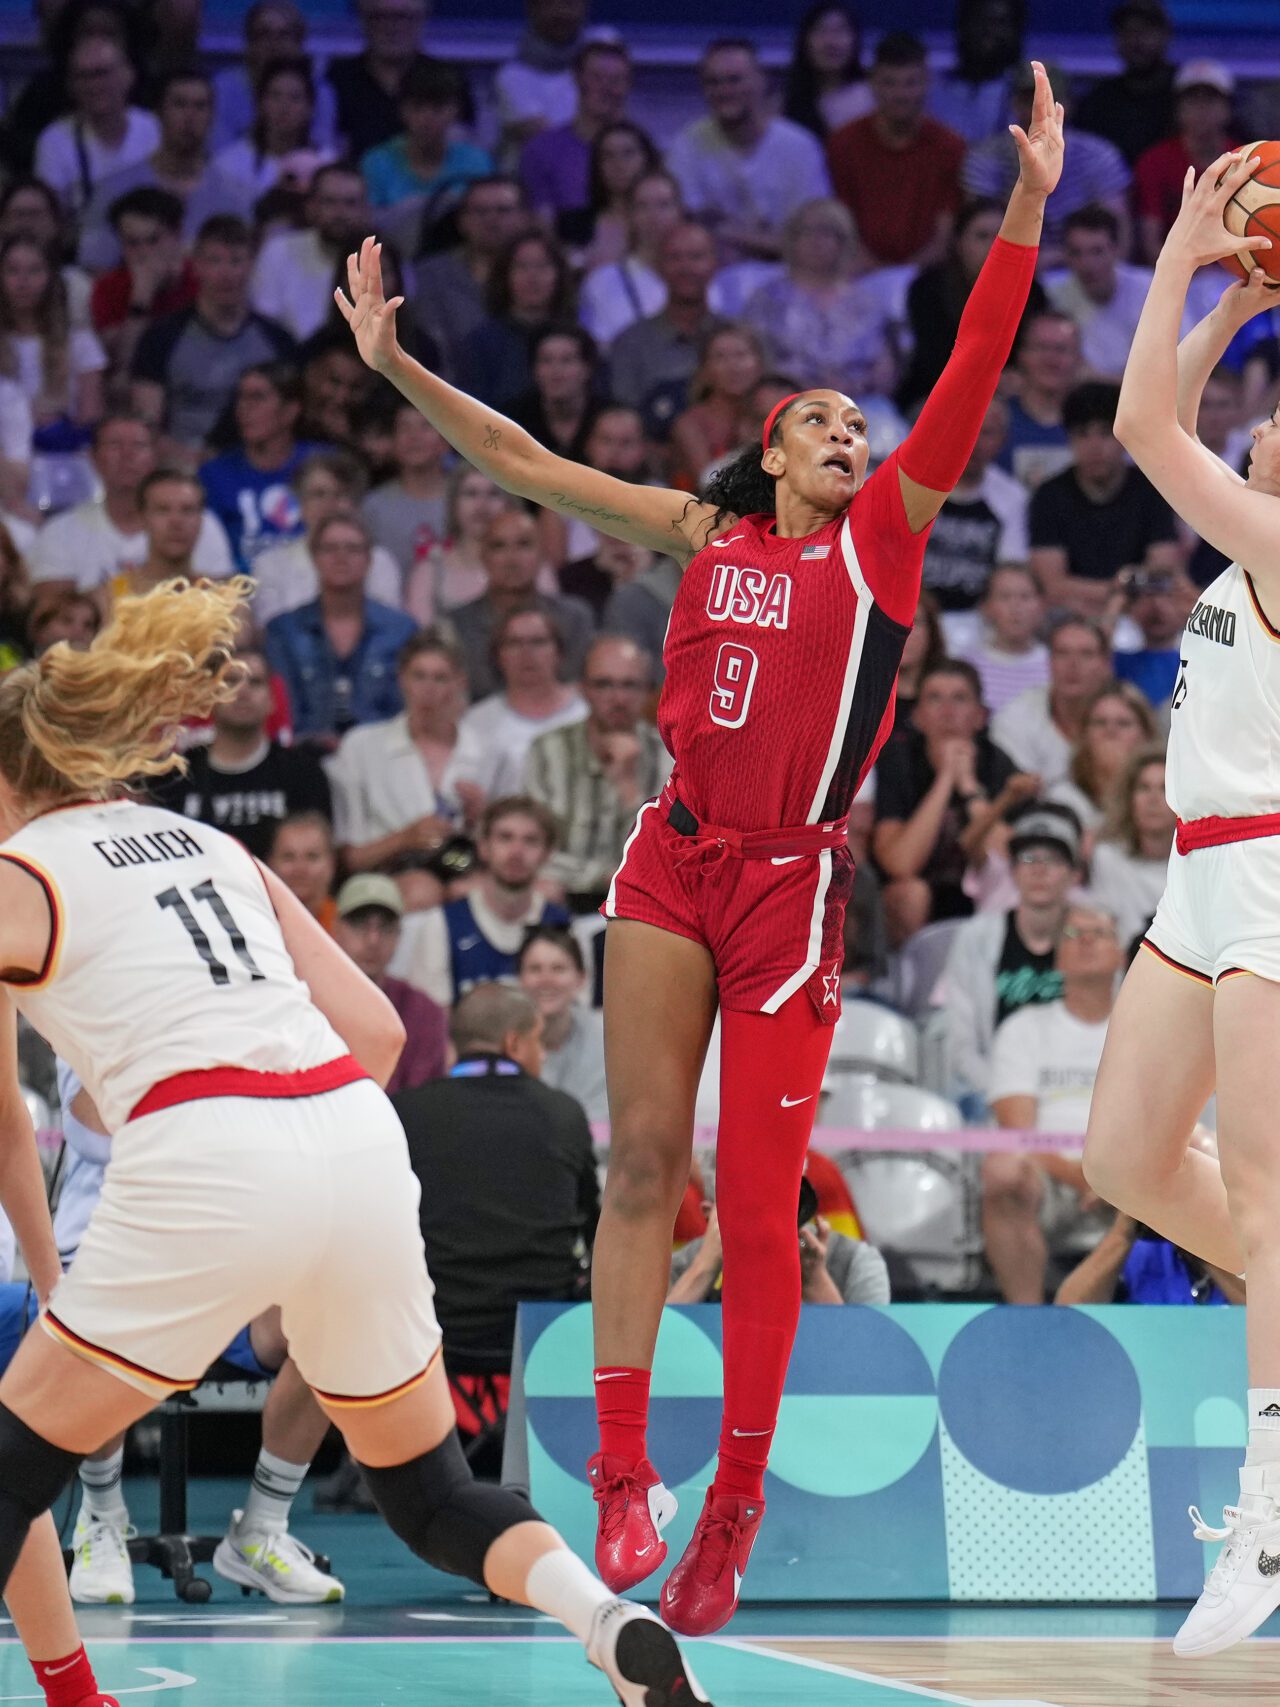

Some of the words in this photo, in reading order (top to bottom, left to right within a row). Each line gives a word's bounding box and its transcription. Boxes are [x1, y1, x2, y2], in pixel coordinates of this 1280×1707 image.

[706, 565, 791, 630] USA
[709, 642, 758, 729] 9
[92, 828, 204, 868] GÜLICH
[154, 878, 266, 985] 11
